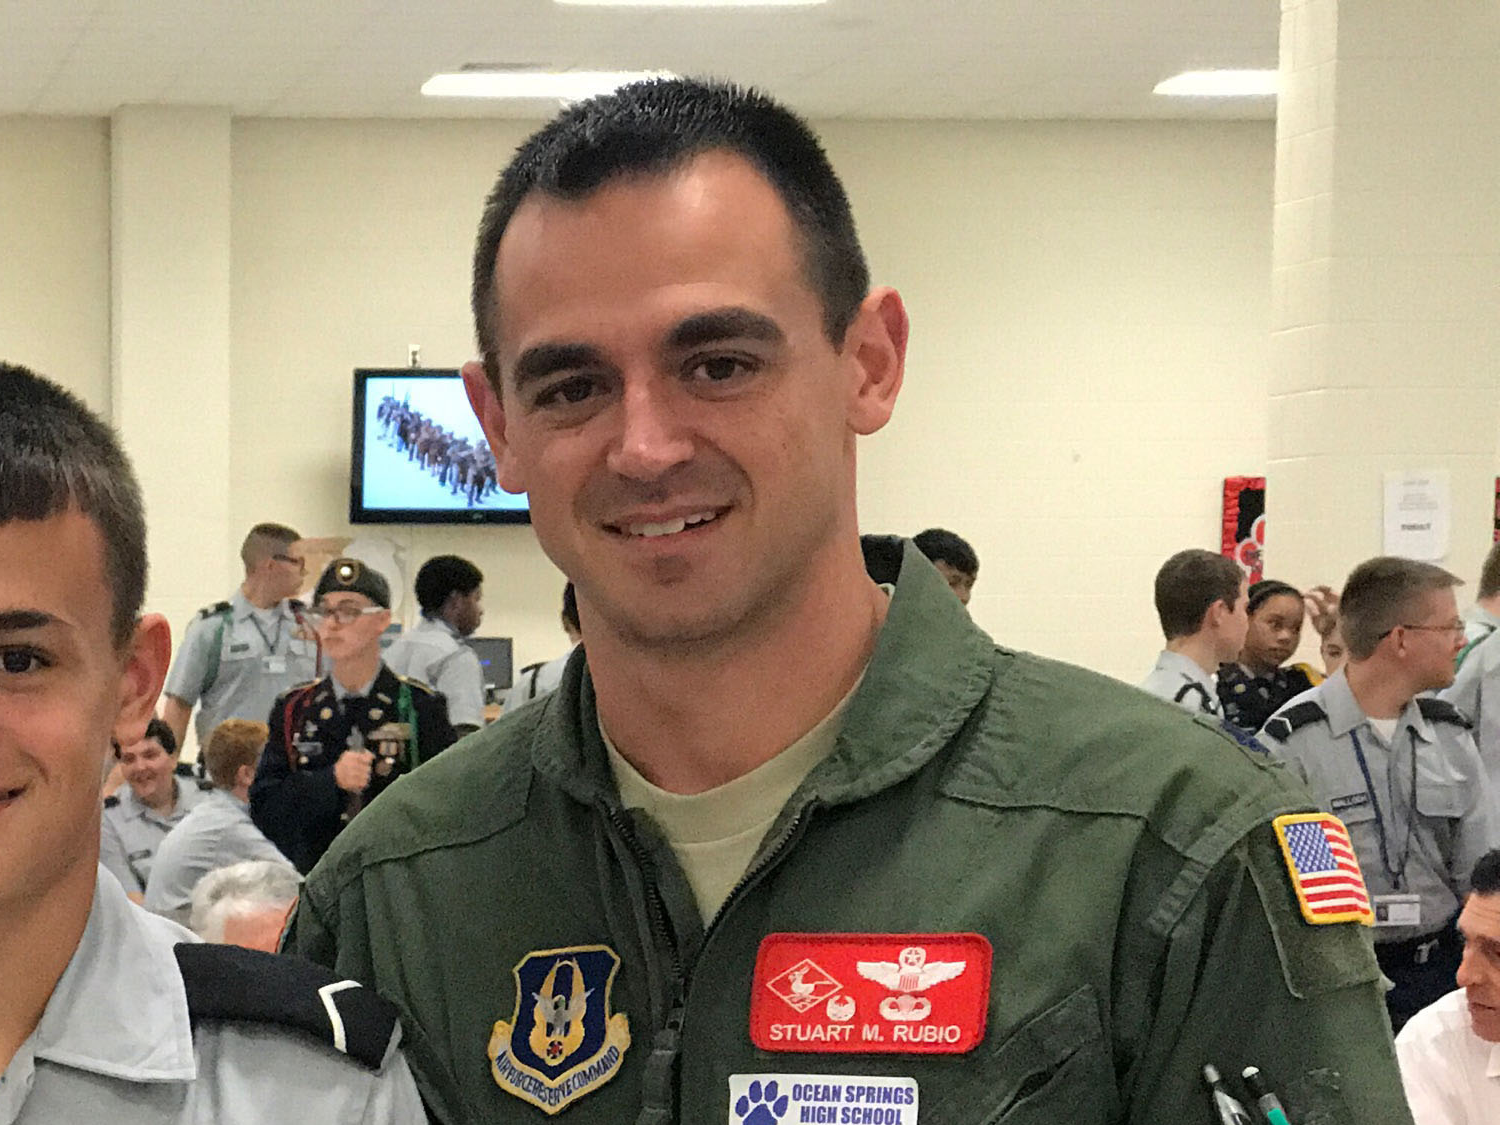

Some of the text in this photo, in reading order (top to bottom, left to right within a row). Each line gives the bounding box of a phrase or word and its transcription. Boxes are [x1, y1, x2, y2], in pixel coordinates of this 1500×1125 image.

[769, 1024, 961, 1043] STUART M. RUBIO
[792, 1083, 915, 1105] OCEAN SPRINGS
[800, 1106, 838, 1124] HIGH
